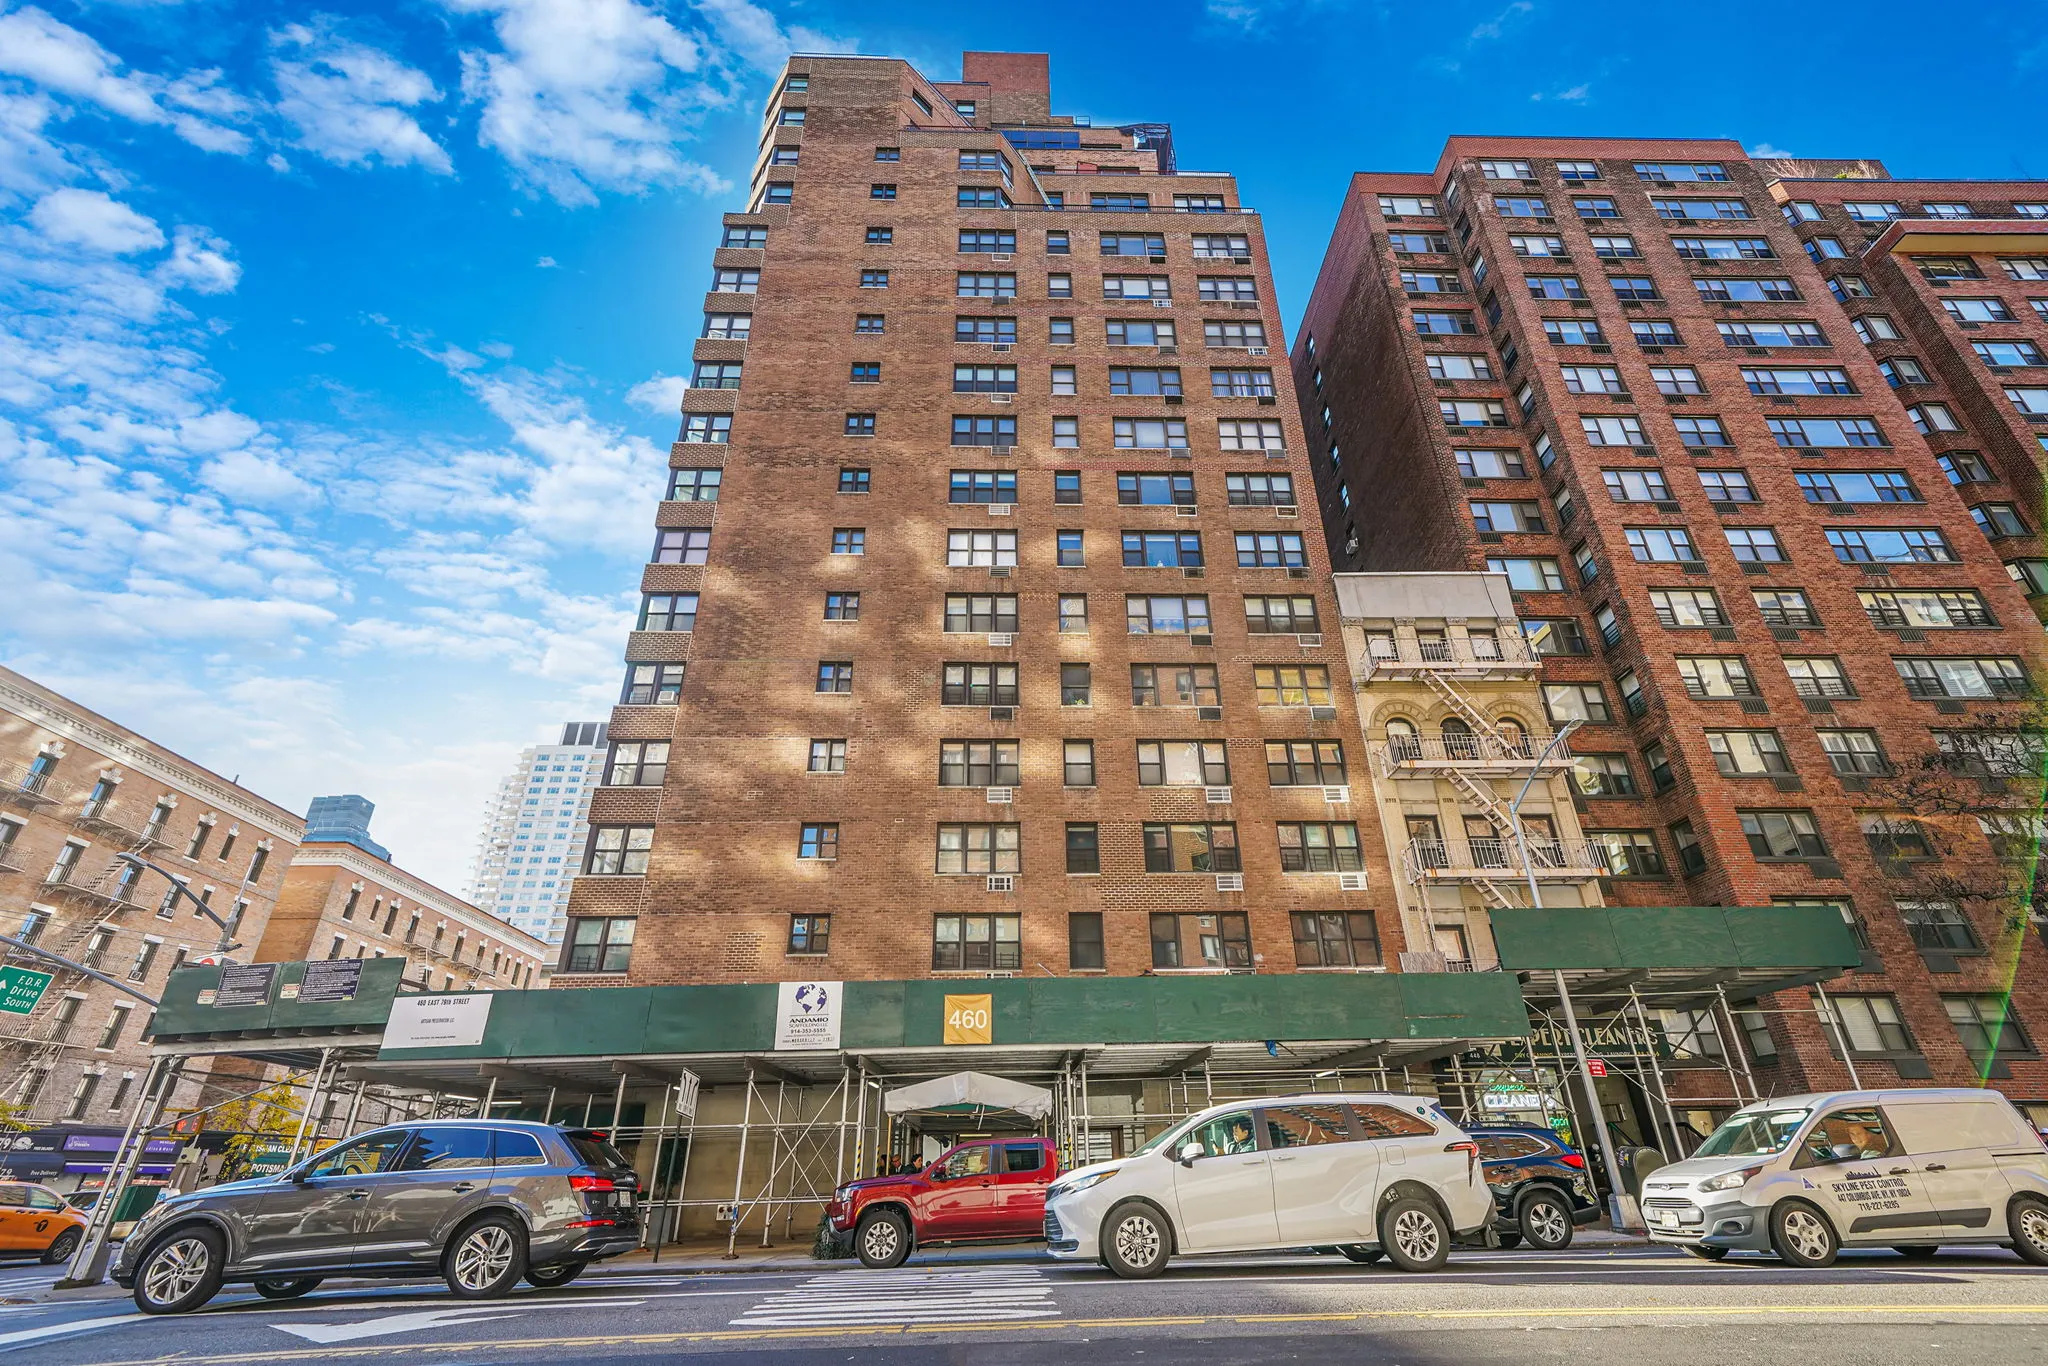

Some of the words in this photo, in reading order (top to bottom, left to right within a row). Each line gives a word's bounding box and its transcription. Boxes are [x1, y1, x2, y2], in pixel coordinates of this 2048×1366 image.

[17, 975, 43, 988] F.D.R.
[10, 985, 39, 999] Drive
[2, 996, 32, 1009] SOUTH
[452, 997, 470, 1005] STREET
[948, 1008, 988, 1029] 460
[1511, 1028, 1572, 1046] PERT
[1484, 1094, 1556, 1109] CLEANES
[250, 1163, 288, 1173] POTISMA
[1832, 1181, 1859, 1193] SKYLINE
[1860, 1180, 1878, 1190] PEST
[1877, 1178, 1907, 1189] CONTROL
[1846, 1191, 1872, 1202] COLUMBUS
